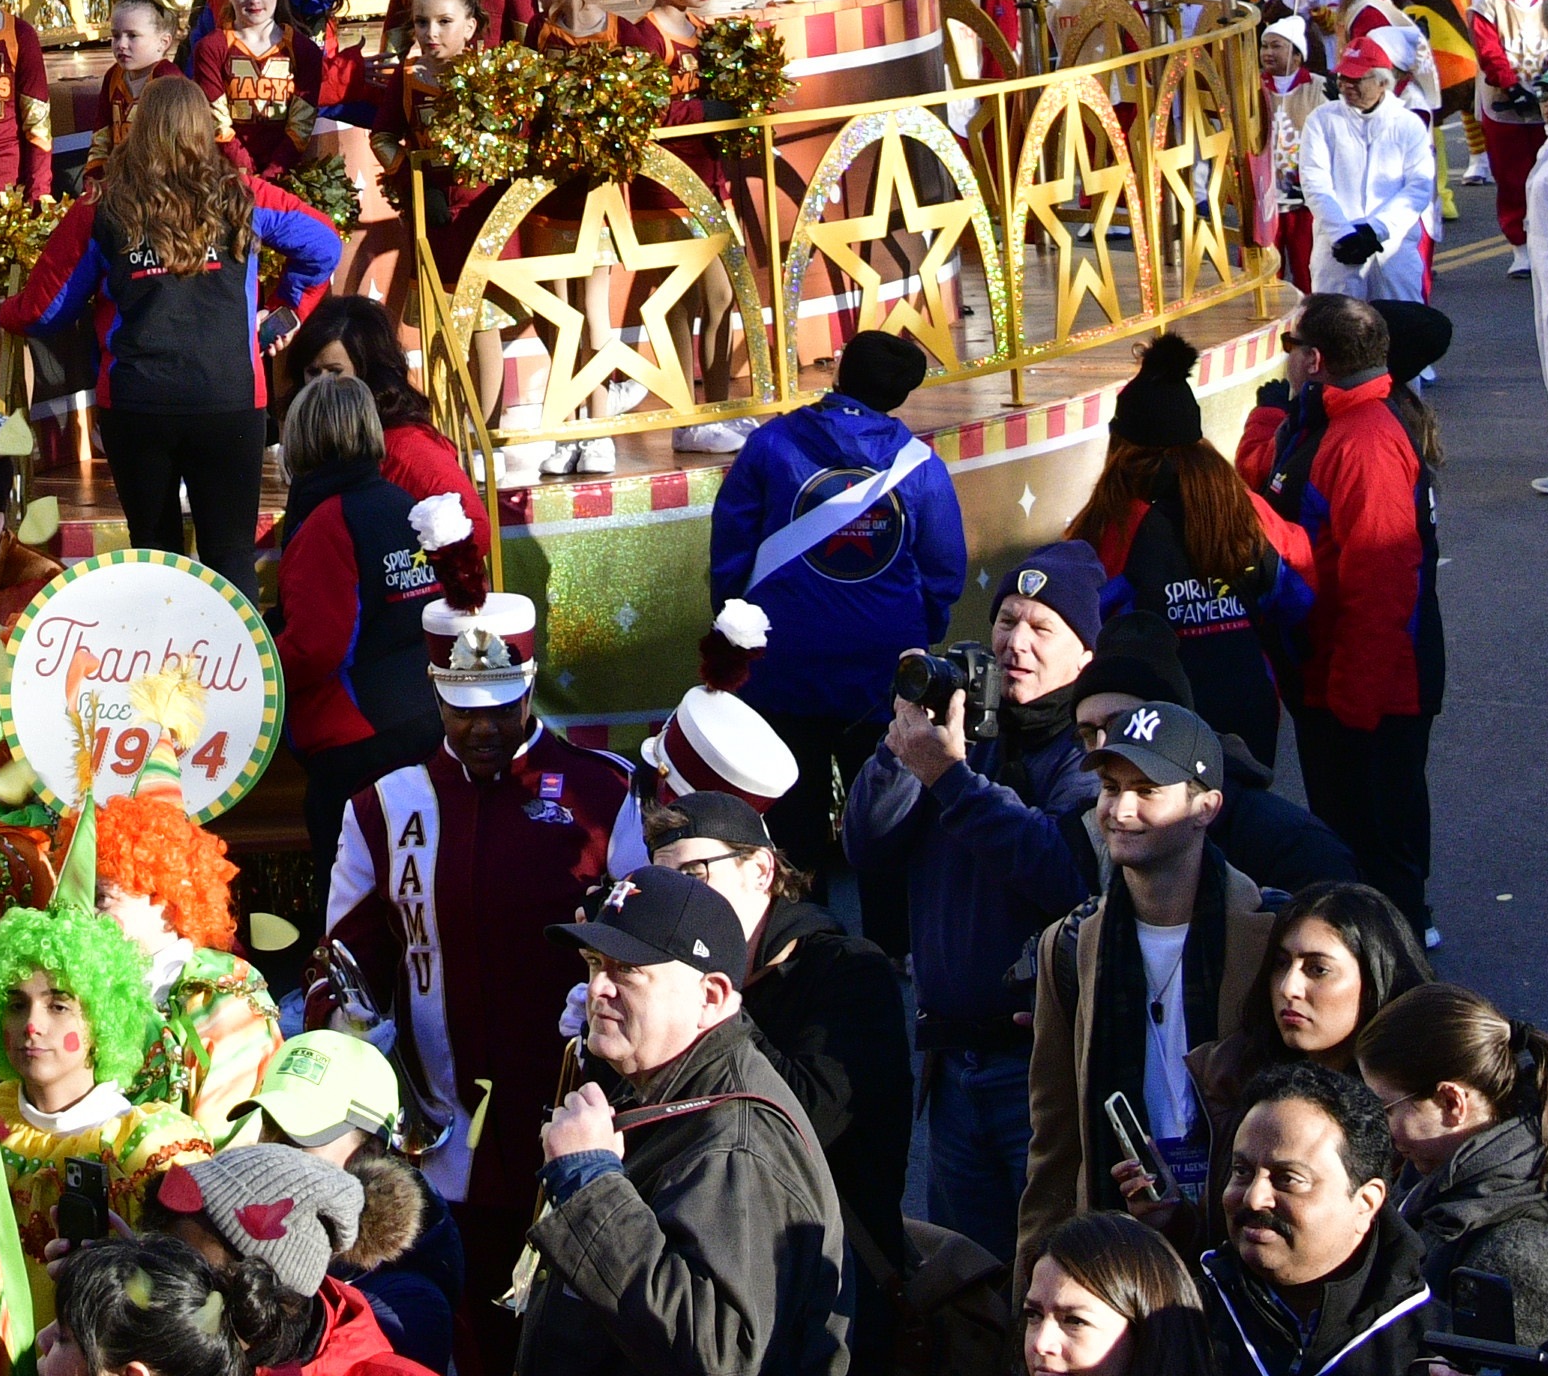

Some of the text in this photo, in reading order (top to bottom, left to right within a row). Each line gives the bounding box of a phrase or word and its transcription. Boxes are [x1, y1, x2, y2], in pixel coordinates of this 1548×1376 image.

[832, 530, 875, 538] ARADE
[384, 572, 400, 587] OF
[1167, 604, 1185, 621] OF
[665, 1099, 711, 1113] Canon
